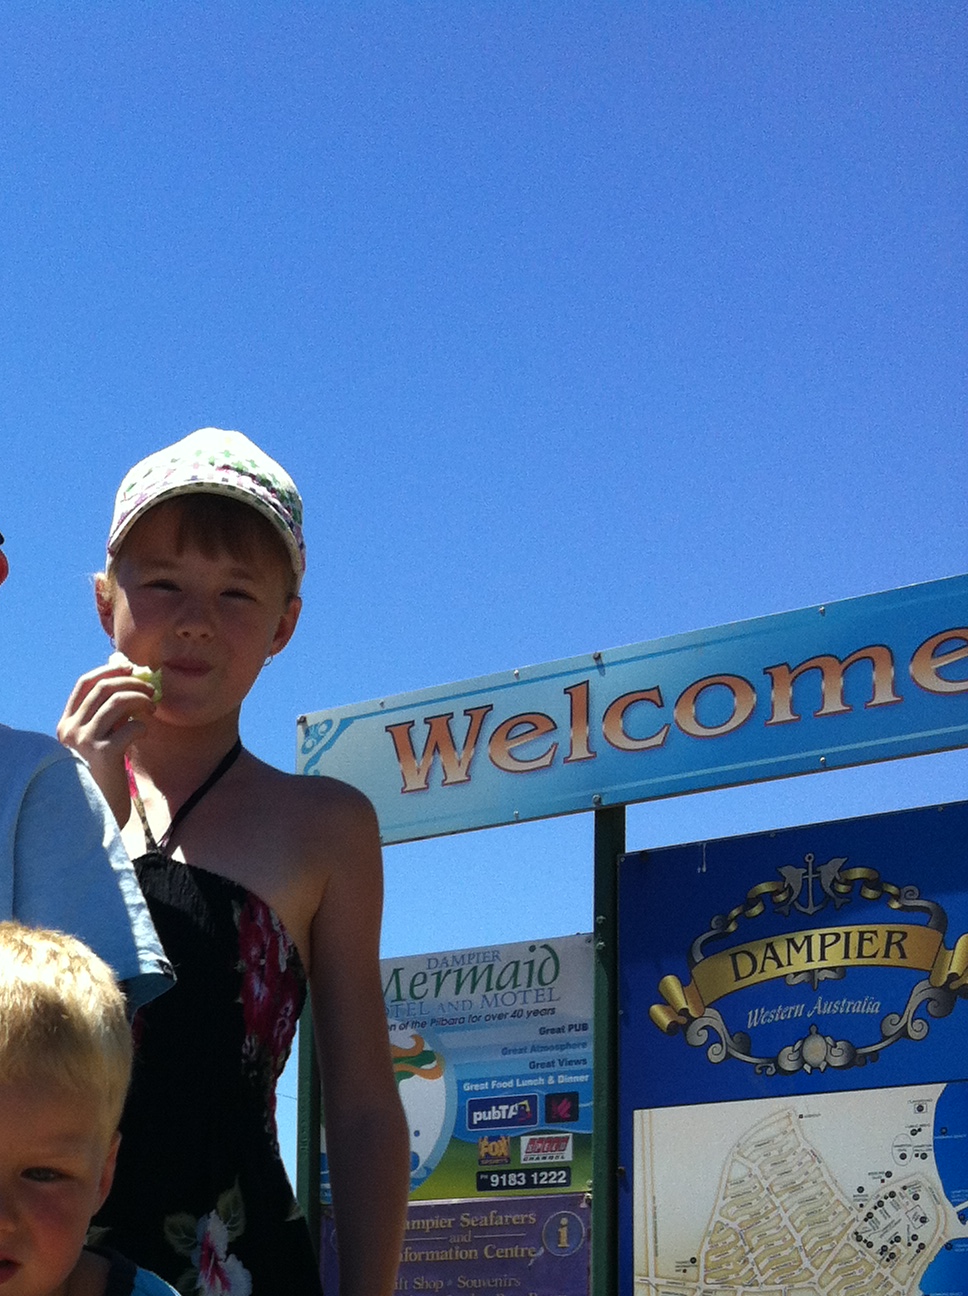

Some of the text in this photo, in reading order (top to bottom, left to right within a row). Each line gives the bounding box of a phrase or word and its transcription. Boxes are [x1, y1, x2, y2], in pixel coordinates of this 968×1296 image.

[385, 626, 968, 794] Welcome
[426, 951, 502, 971] DAMPIER
[729, 929, 908, 983] DAMPIER
[386, 987, 561, 1018] TEL AND MOTEL
[399, 1021, 410, 1031] of
[411, 1019, 427, 1029] the
[430, 1016, 465, 1027] Pilbara
[468, 1013, 482, 1023] for
[485, 1012, 509, 1022] over
[511, 1010, 523, 1019] 40
[526, 1007, 556, 1020] years
[747, 996, 881, 1029] Western Australia
[539, 1023, 588, 1035] Great PUB
[501, 1041, 587, 1055] Great Atmosphere
[529, 1058, 587, 1070] Great Views
[463, 1074, 589, 1092] Great Food Lunch & Dinner
[480, 1136, 510, 1159] FOX
[490, 1172, 526, 1187] 9183
[532, 1170, 567, 1185] 1222
[405, 1210, 536, 1232] ampier Seafarers
[449, 1230, 472, 1243] and
[400, 1244, 536, 1262] nformation Centre
[395, 1274, 521, 1292] ift Shop Souvenirs
